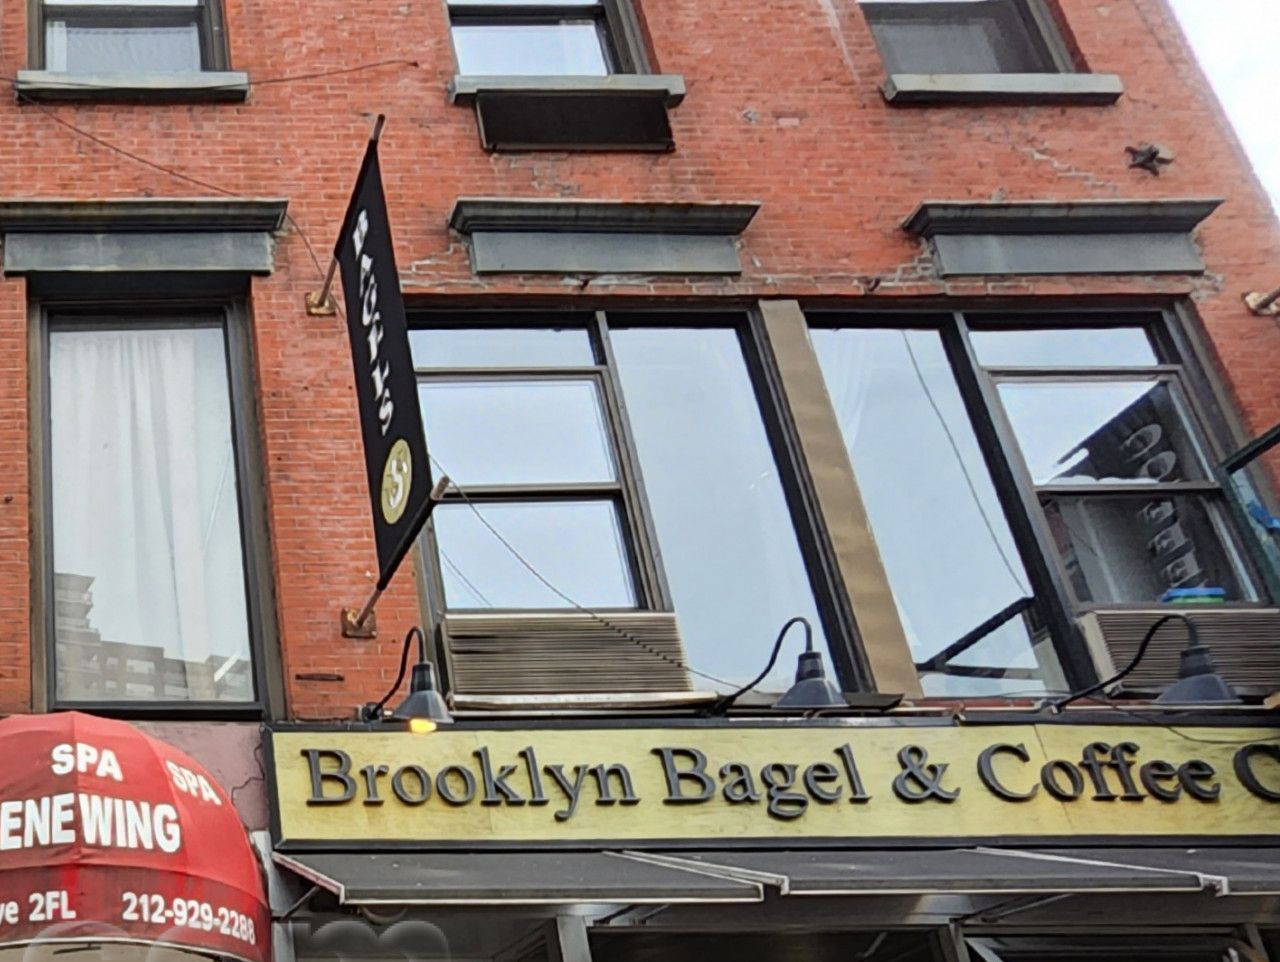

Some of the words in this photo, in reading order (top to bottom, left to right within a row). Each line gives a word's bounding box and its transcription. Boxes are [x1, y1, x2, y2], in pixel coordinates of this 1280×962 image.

[51, 742, 124, 782] SPA
[165, 759, 222, 806] SPA
[299, 745, 641, 822] Brooklyn
[649, 743, 873, 822] Bagel
[891, 743, 963, 805] &
[976, 741, 1222, 805] Coffee
[28, 890, 77, 922] 2FL
[121, 891, 257, 946] 212-929-2288
